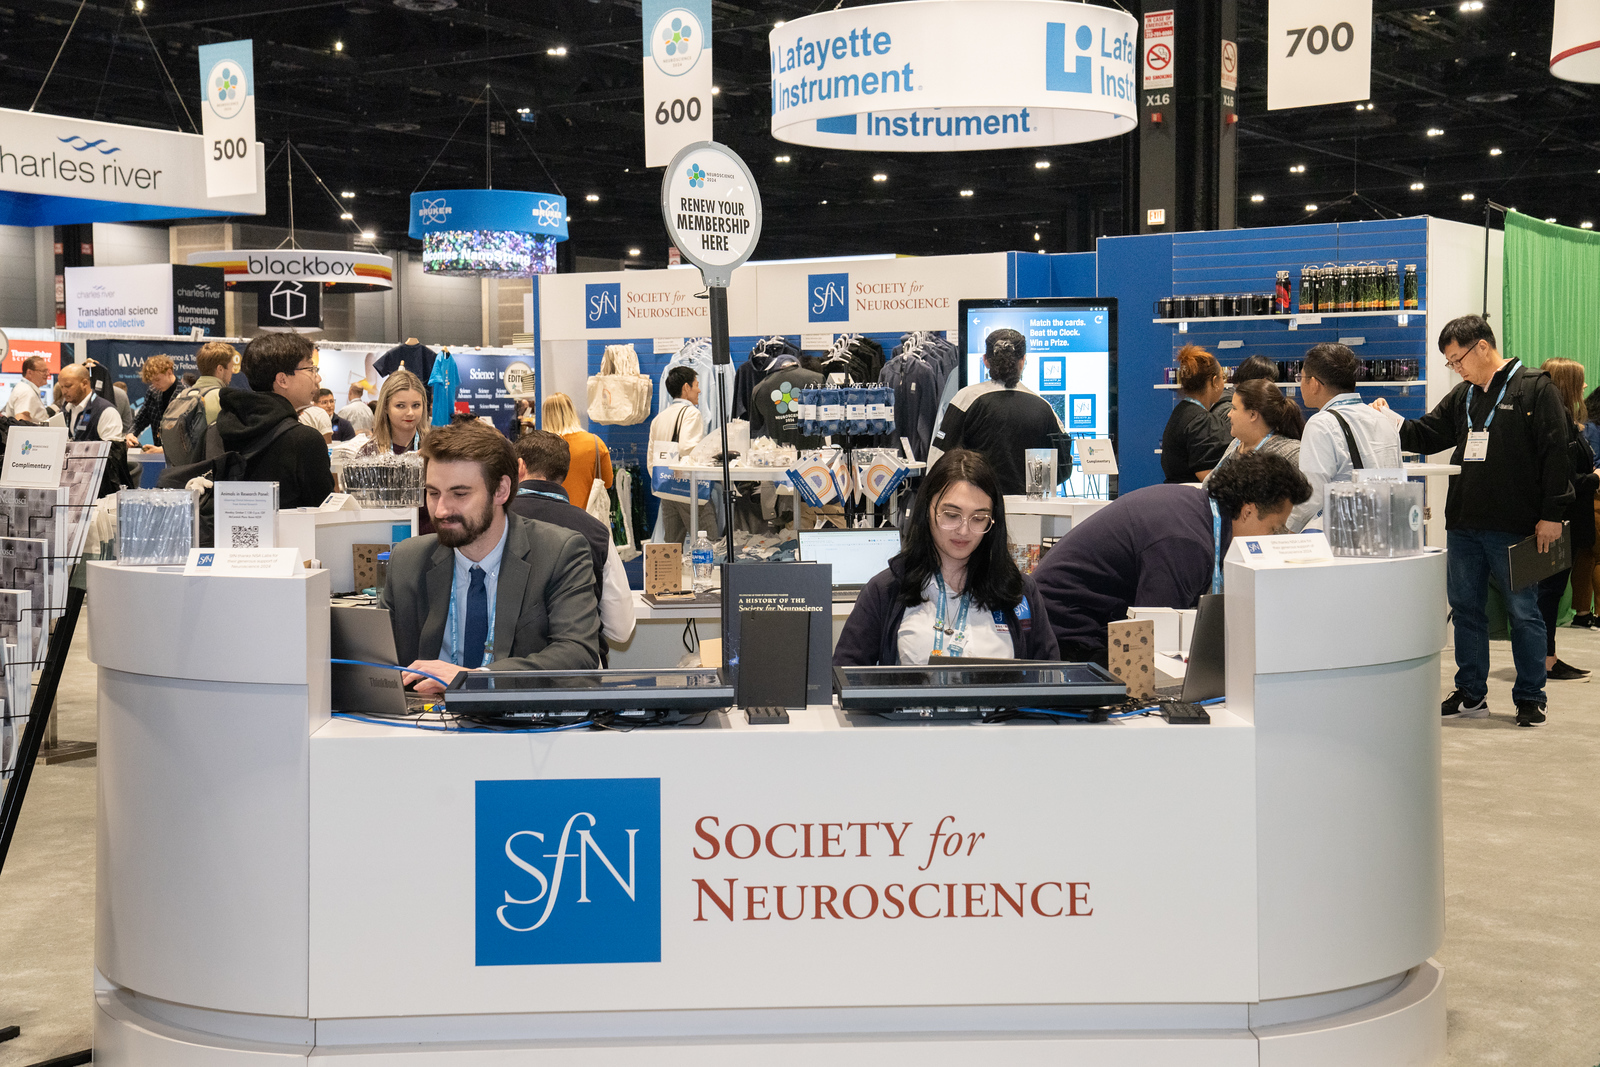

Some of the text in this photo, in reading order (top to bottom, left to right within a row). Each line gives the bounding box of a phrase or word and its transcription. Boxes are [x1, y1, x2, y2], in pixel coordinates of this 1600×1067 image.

[1286, 22, 1354, 58] 700
[778, 26, 892, 71] Lafayette
[779, 62, 914, 112] Instrument
[1146, 94, 1170, 106] X16
[1223, 94, 1234, 107] X16
[656, 96, 702, 126] 600
[867, 107, 1030, 136] Instrument
[214, 137, 248, 162] 500
[103, 159, 162, 190] river
[419, 206, 452, 216] BRUKER
[532, 208, 562, 219] BRUKER
[680, 197, 745, 216] RENEW YOUR
[1149, 210, 1162, 220] EXIT
[677, 214, 750, 234] MEMBERSHIP
[702, 234, 729, 251] HERE
[249, 255, 356, 276] blackbox
[460, 250, 530, 266] NanoString
[177, 287, 221, 299] charles river
[855, 281, 924, 296] SOCIETY for
[626, 290, 686, 306] SOCIETY for
[812, 282, 844, 314] SfN
[856, 297, 950, 311] NEUROSCIENCE
[78, 306, 158, 317] Translational science
[178, 305, 219, 315] Momentum
[589, 291, 617, 322] SfN
[626, 306, 708, 318] NEUROSCIENCE
[78, 318, 145, 328] built on collective
[178, 316, 216, 325] surpasses
[470, 368, 494, 379] Science
[12, 462, 52, 470] Complimentary
[692, 814, 986, 871] SOCIETY for
[496, 812, 640, 932] SfN
[691, 877, 1094, 922] NEUROSCIENCE
